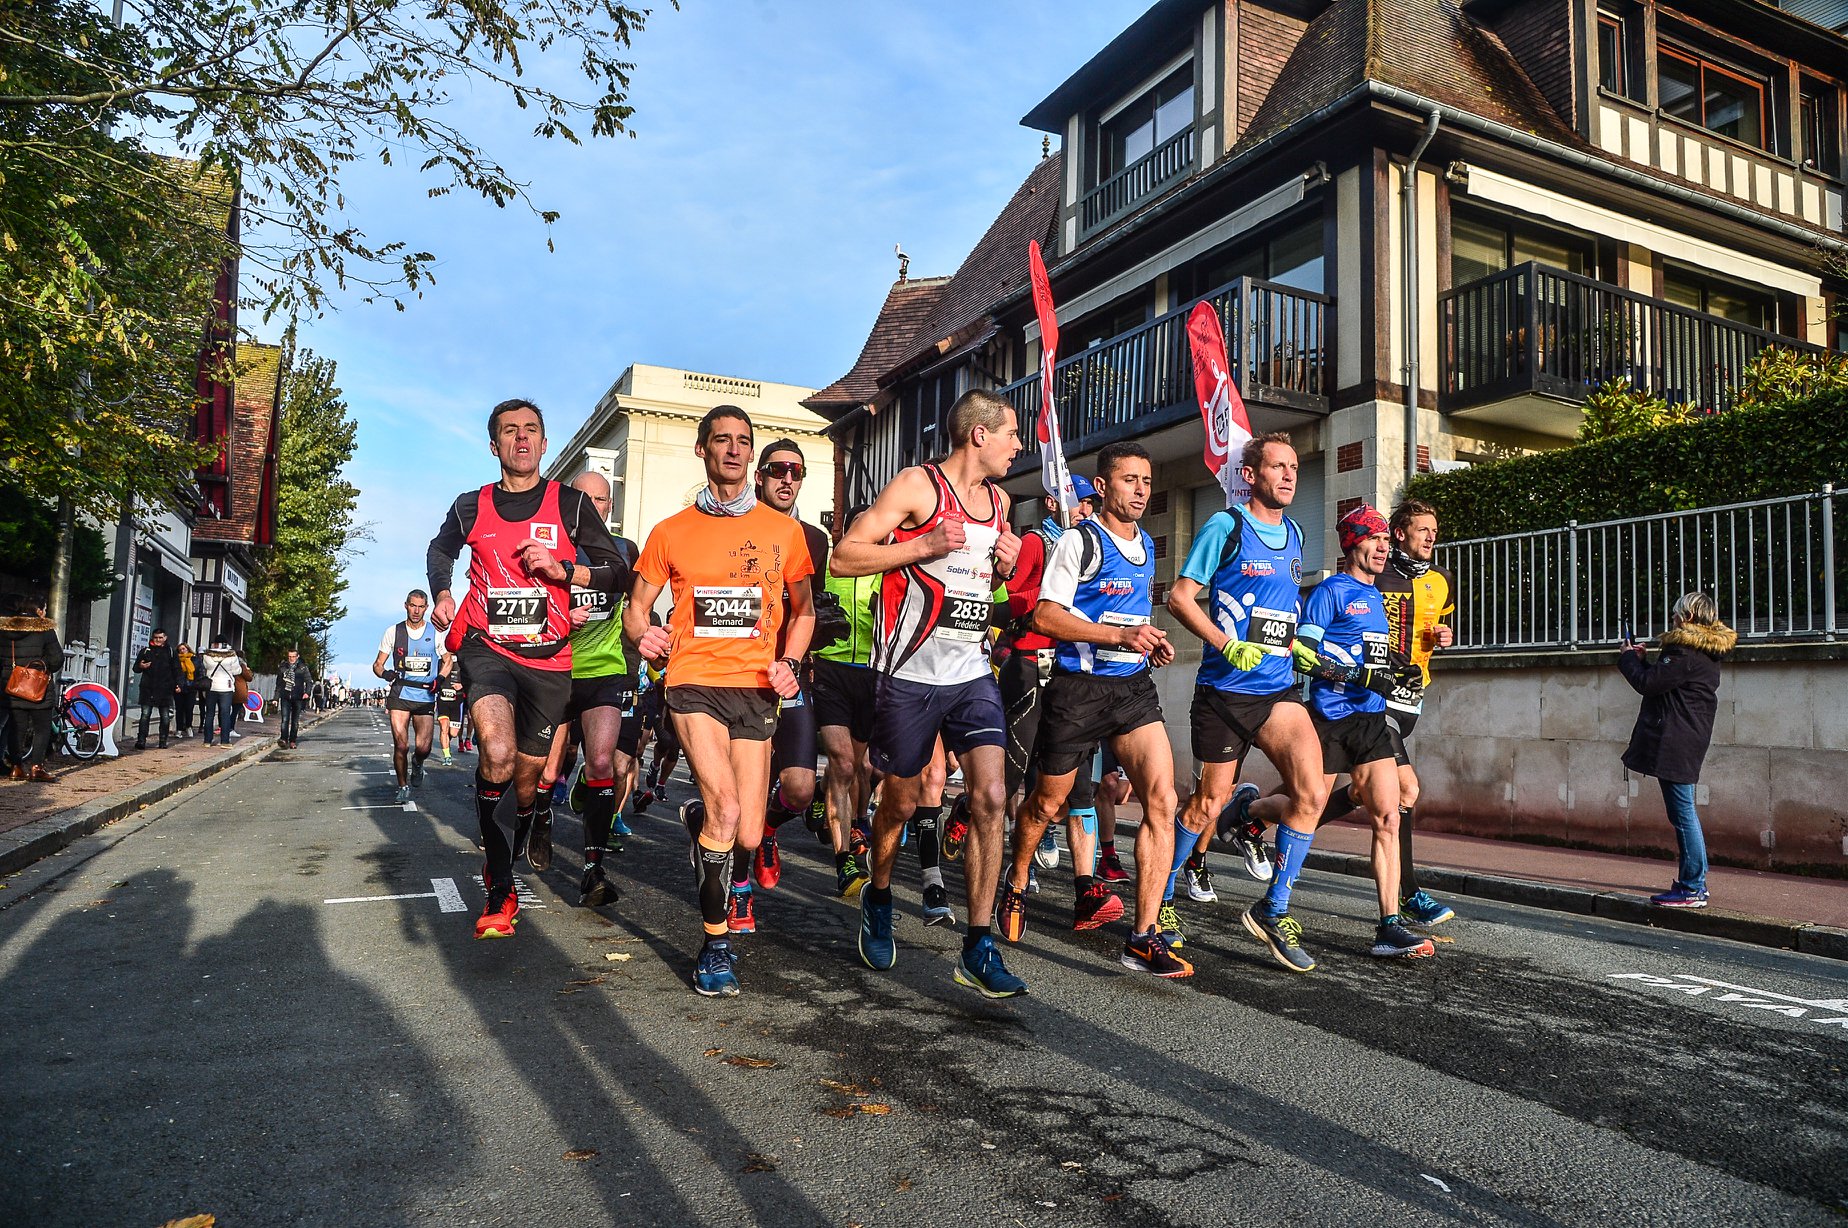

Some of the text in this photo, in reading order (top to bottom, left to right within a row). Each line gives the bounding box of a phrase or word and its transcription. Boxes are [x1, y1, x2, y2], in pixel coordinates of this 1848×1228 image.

[1234, 489, 1252, 497] INTE
[979, 572, 992, 580] spor
[953, 590, 979, 598] INTERSPORT
[574, 592, 608, 607] 1013
[496, 599, 540, 616] 2717
[704, 599, 752, 617] 2044
[950, 600, 989, 621] 2833
[712, 618, 744, 626] Bernard
[954, 620, 981, 630] Frédéric
[1389, 597, 1400, 654] TRIATHLON
[1262, 620, 1287, 638] 408
[1263, 636, 1283, 646] Fabien
[410, 661, 428, 669] 1992
